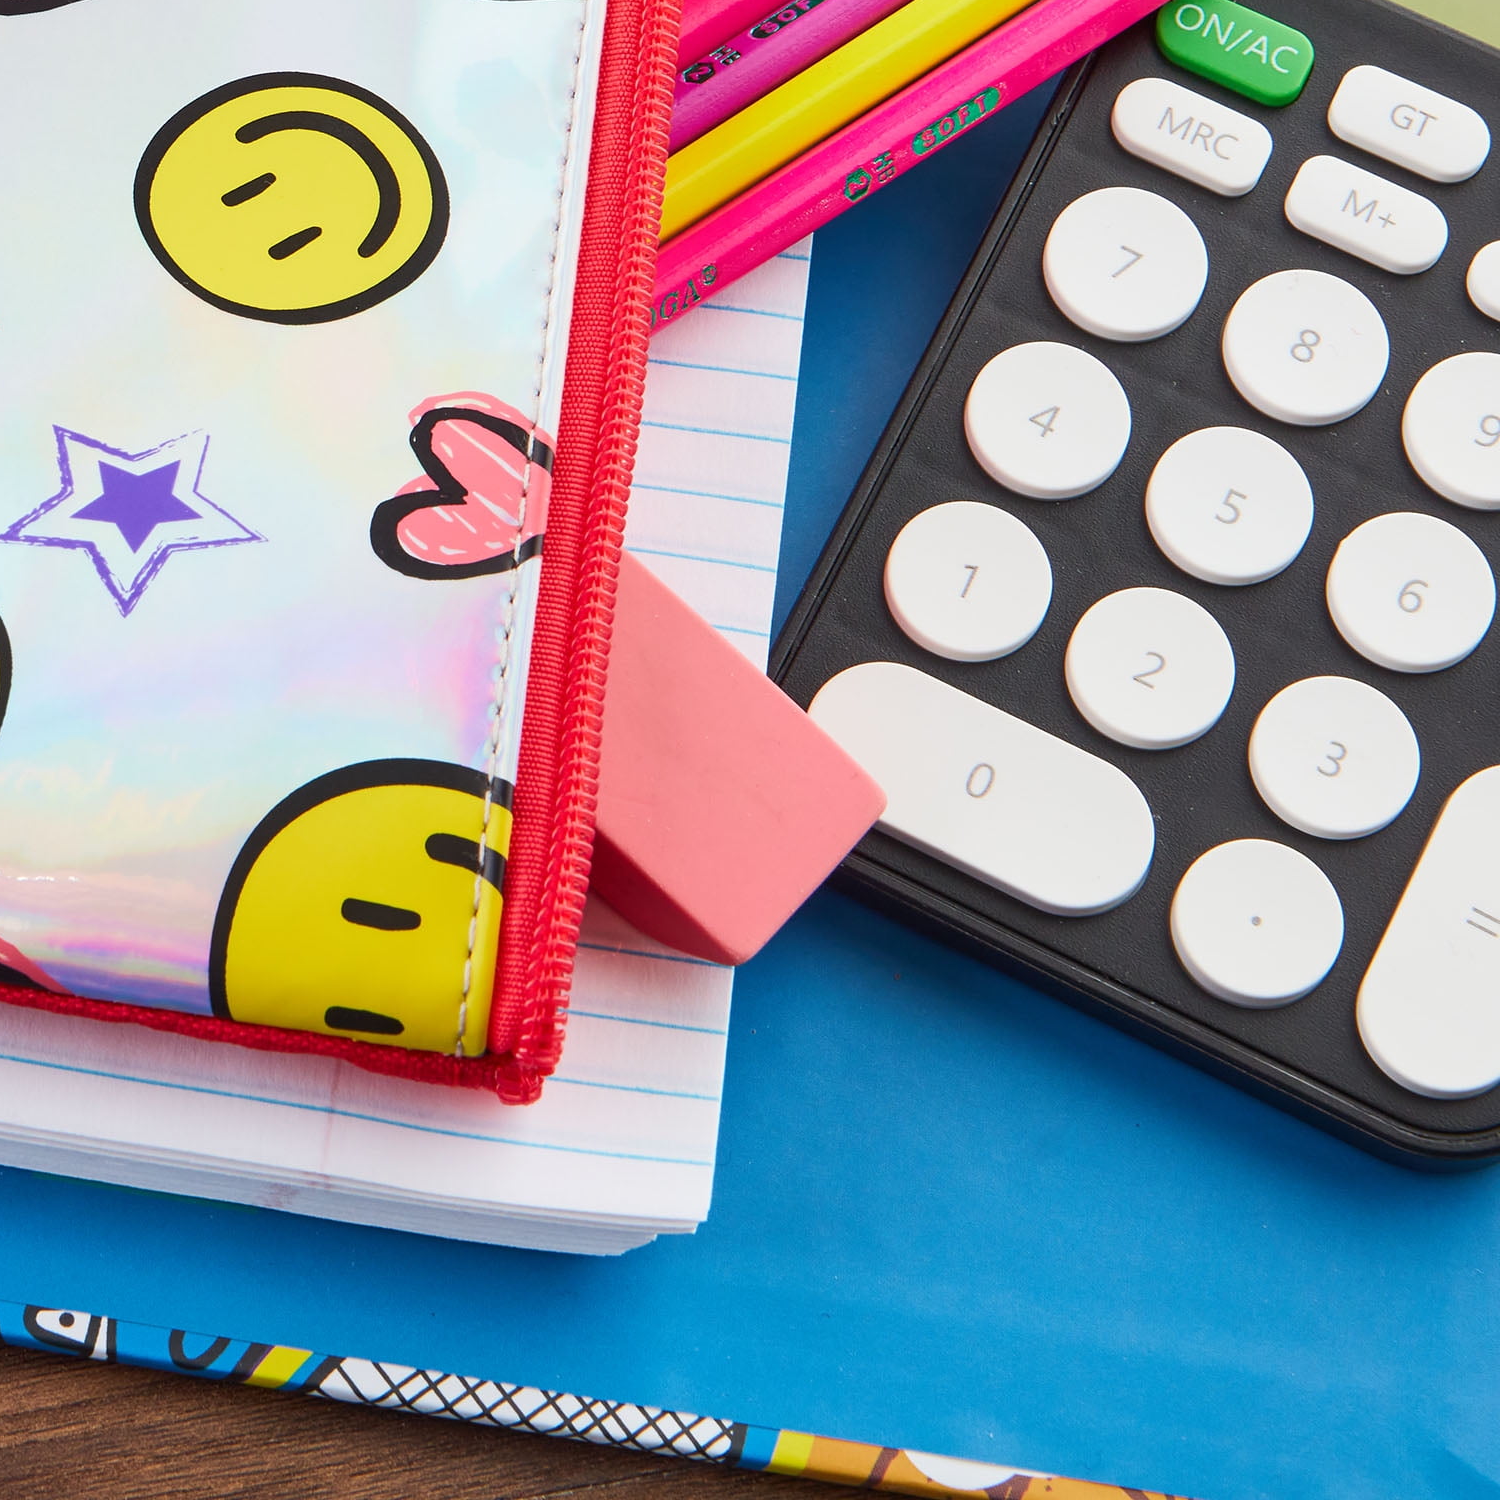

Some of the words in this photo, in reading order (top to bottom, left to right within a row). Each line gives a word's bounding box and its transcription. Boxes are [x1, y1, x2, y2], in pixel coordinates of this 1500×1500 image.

[708, 44, 742, 67] HB
[1175, 3, 1299, 74] ON/AC
[920, 94, 987, 149] SOFT
[1157, 105, 1239, 160] MRC
[1389, 103, 1438, 137] GT
[872, 150, 897, 185] HB
[1341, 188, 1397, 229] M+
[1111, 245, 1143, 280] 7
[1289, 329, 1321, 364] 8
[1028, 405, 1062, 439] 4
[1473, 414, 1500, 448] 9
[1214, 488, 1248, 526] 5
[959, 564, 979, 600] 1
[1397, 577, 1429, 614] 6
[1132, 651, 1167, 690] 2
[1316, 740, 1348, 779] 3
[965, 761, 996, 799] 0
